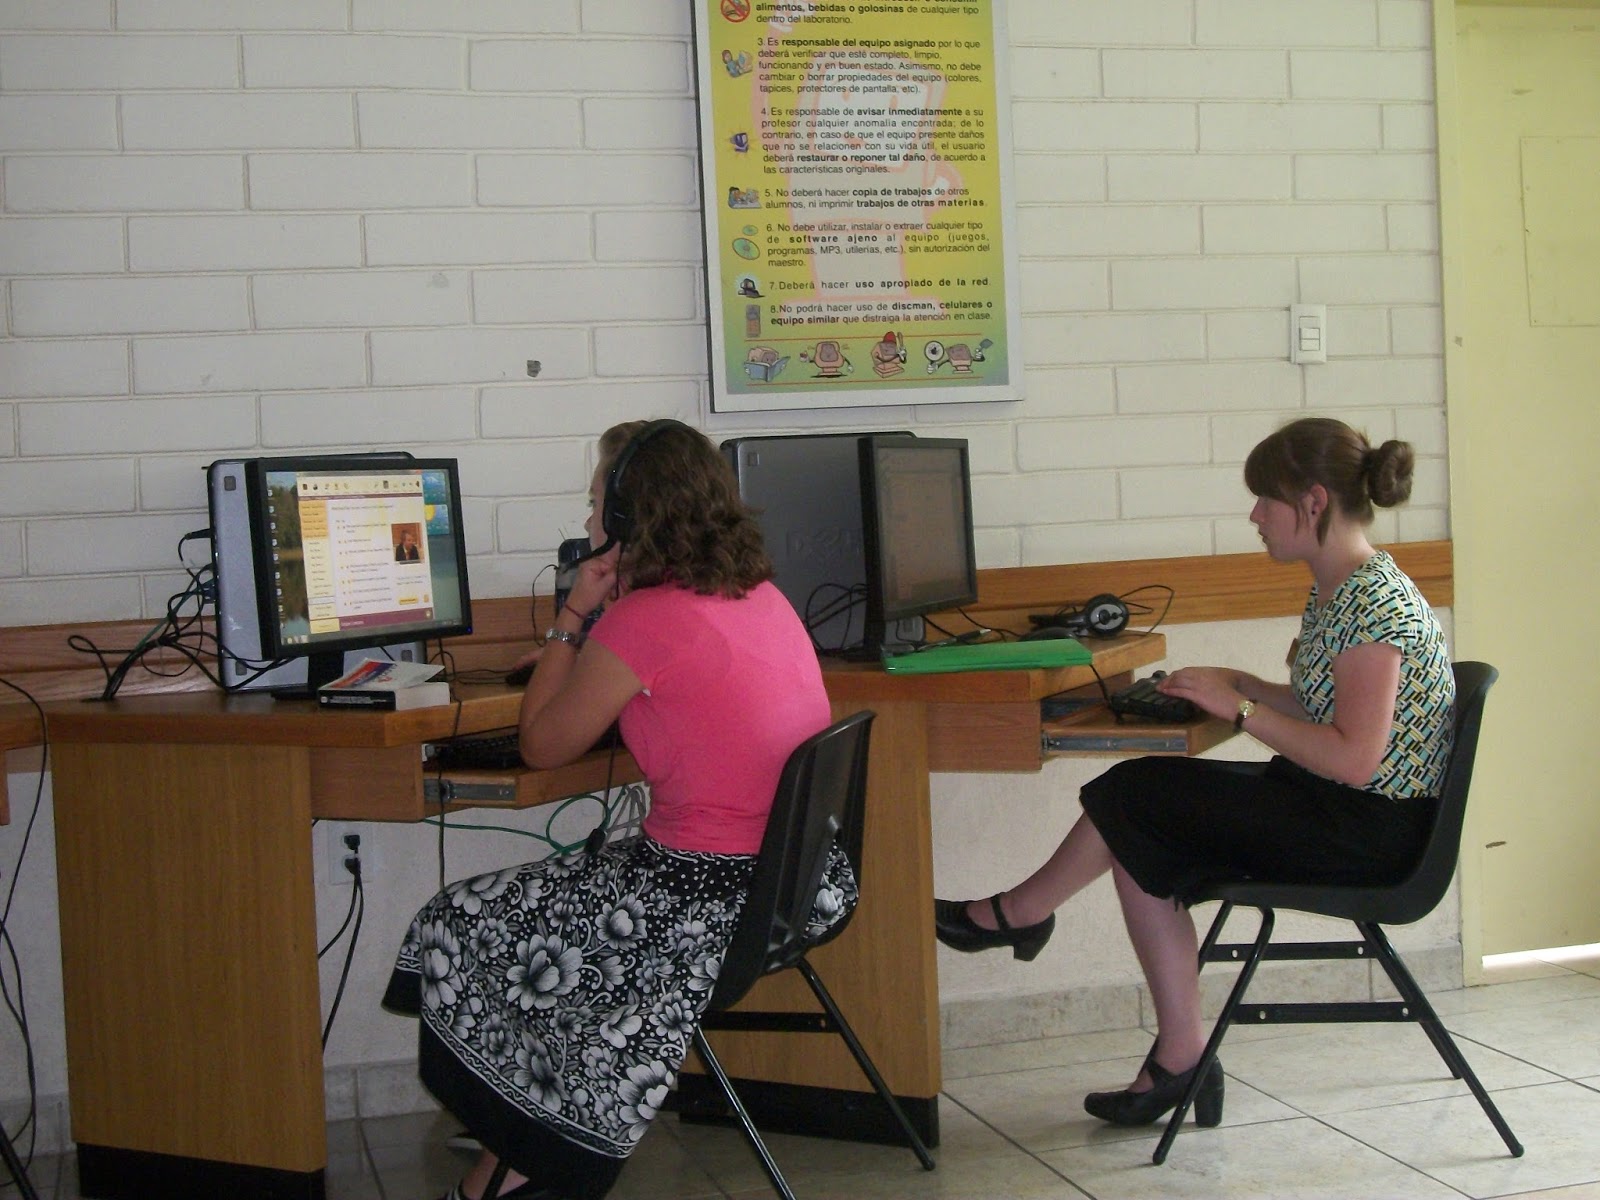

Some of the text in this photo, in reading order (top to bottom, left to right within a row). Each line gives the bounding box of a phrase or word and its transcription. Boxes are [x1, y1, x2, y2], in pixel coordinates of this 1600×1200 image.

[756, 3, 805, 12] alimentos,
[808, 3, 845, 12] bebidas
[858, 5, 904, 14] golosinas
[907, 5, 918, 13] de
[921, 6, 960, 14] cualquier
[963, 6, 979, 14] tipo
[756, 15, 785, 23] dentro
[788, 15, 801, 23] del
[767, 37, 779, 46] Es
[782, 39, 840, 47] responsable
[859, 39, 891, 48] equipo
[894, 39, 936, 48] asignado
[938, 40, 951, 48] por
[758, 50, 789, 58] deberá
[792, 50, 827, 58] verificar
[829, 51, 846, 59] que
[914, 51, 942, 59] limpio,
[758, 61, 814, 69] funcionando
[816, 63, 822, 71] y
[864, 62, 896, 70] estado.
[899, 62, 944, 71] Asimismo,
[946, 63, 957, 71] no
[960, 63, 981, 71] debe
[807, 73, 835, 81] borrar
[838, 74, 892, 82] propiedades
[912, 74, 941, 83] equipo
[945, 75, 982, 83] (colores,
[760, 85, 794, 93] tapices,
[797, 85, 847, 93] protectores
[849, 84, 860, 92] de
[771, 107, 782, 115] Es
[785, 108, 840, 117] responsable
[889, 108, 962, 116] inmediatamente
[761, 120, 801, 128] profesor
[806, 120, 849, 128] cualquier
[762, 131, 804, 139] contrario,
[844, 131, 855, 139] de
[857, 132, 874, 141] que
[877, 131, 884, 139] el
[887, 131, 916, 140] equipo
[919, 131, 956, 140] presente
[959, 131, 985, 139] daños
[762, 144, 780, 152] que
[814, 142, 861, 150] relacionen
[899, 142, 918, 150] vida
[763, 154, 794, 162] deberá
[797, 154, 839, 162] restaurar
[850, 155, 886, 163] reponer
[930, 153, 941, 161] de
[944, 153, 978, 161] acuerdo
[763, 166, 776, 174] las
[846, 165, 890, 175] originales.
[776, 189, 789, 197] No
[791, 188, 822, 197] deberá
[852, 188, 878, 197] copia
[880, 188, 892, 196] de
[895, 188, 932, 198] trabajos
[765, 200, 806, 209] alumnos,
[808, 200, 816, 208] ni
[819, 200, 854, 209] imprimir
[856, 200, 894, 209] trabajos
[898, 199, 909, 207] de
[911, 199, 935, 207] otras
[777, 223, 790, 231] No
[793, 223, 815, 231] debe
[818, 222, 849, 231] utilizar,
[851, 222, 883, 231] instalar
[893, 222, 923, 230] extraer
[926, 221, 965, 231] cualquier
[968, 222, 983, 231] tipo
[767, 233, 989, 244] de software ajeno al equipo (juegos,
[909, 245, 921, 253] sin
[924, 244, 975, 252] autorización
[977, 243, 990, 251] del
[821, 281, 849, 289] hacer
[881, 279, 933, 289] apropiado
[957, 278, 966, 286] la
[796, 304, 822, 314] podrá
[826, 304, 852, 312] hacer
[877, 303, 888, 311] de
[892, 302, 936, 311] discman,
[939, 301, 983, 309] celulares
[771, 317, 804, 326] equipo
[807, 316, 839, 324] similar
[843, 316, 859, 324] que
[862, 314, 900, 324] distraiga
[902, 313, 911, 321] la
[914, 313, 951, 321] atención
